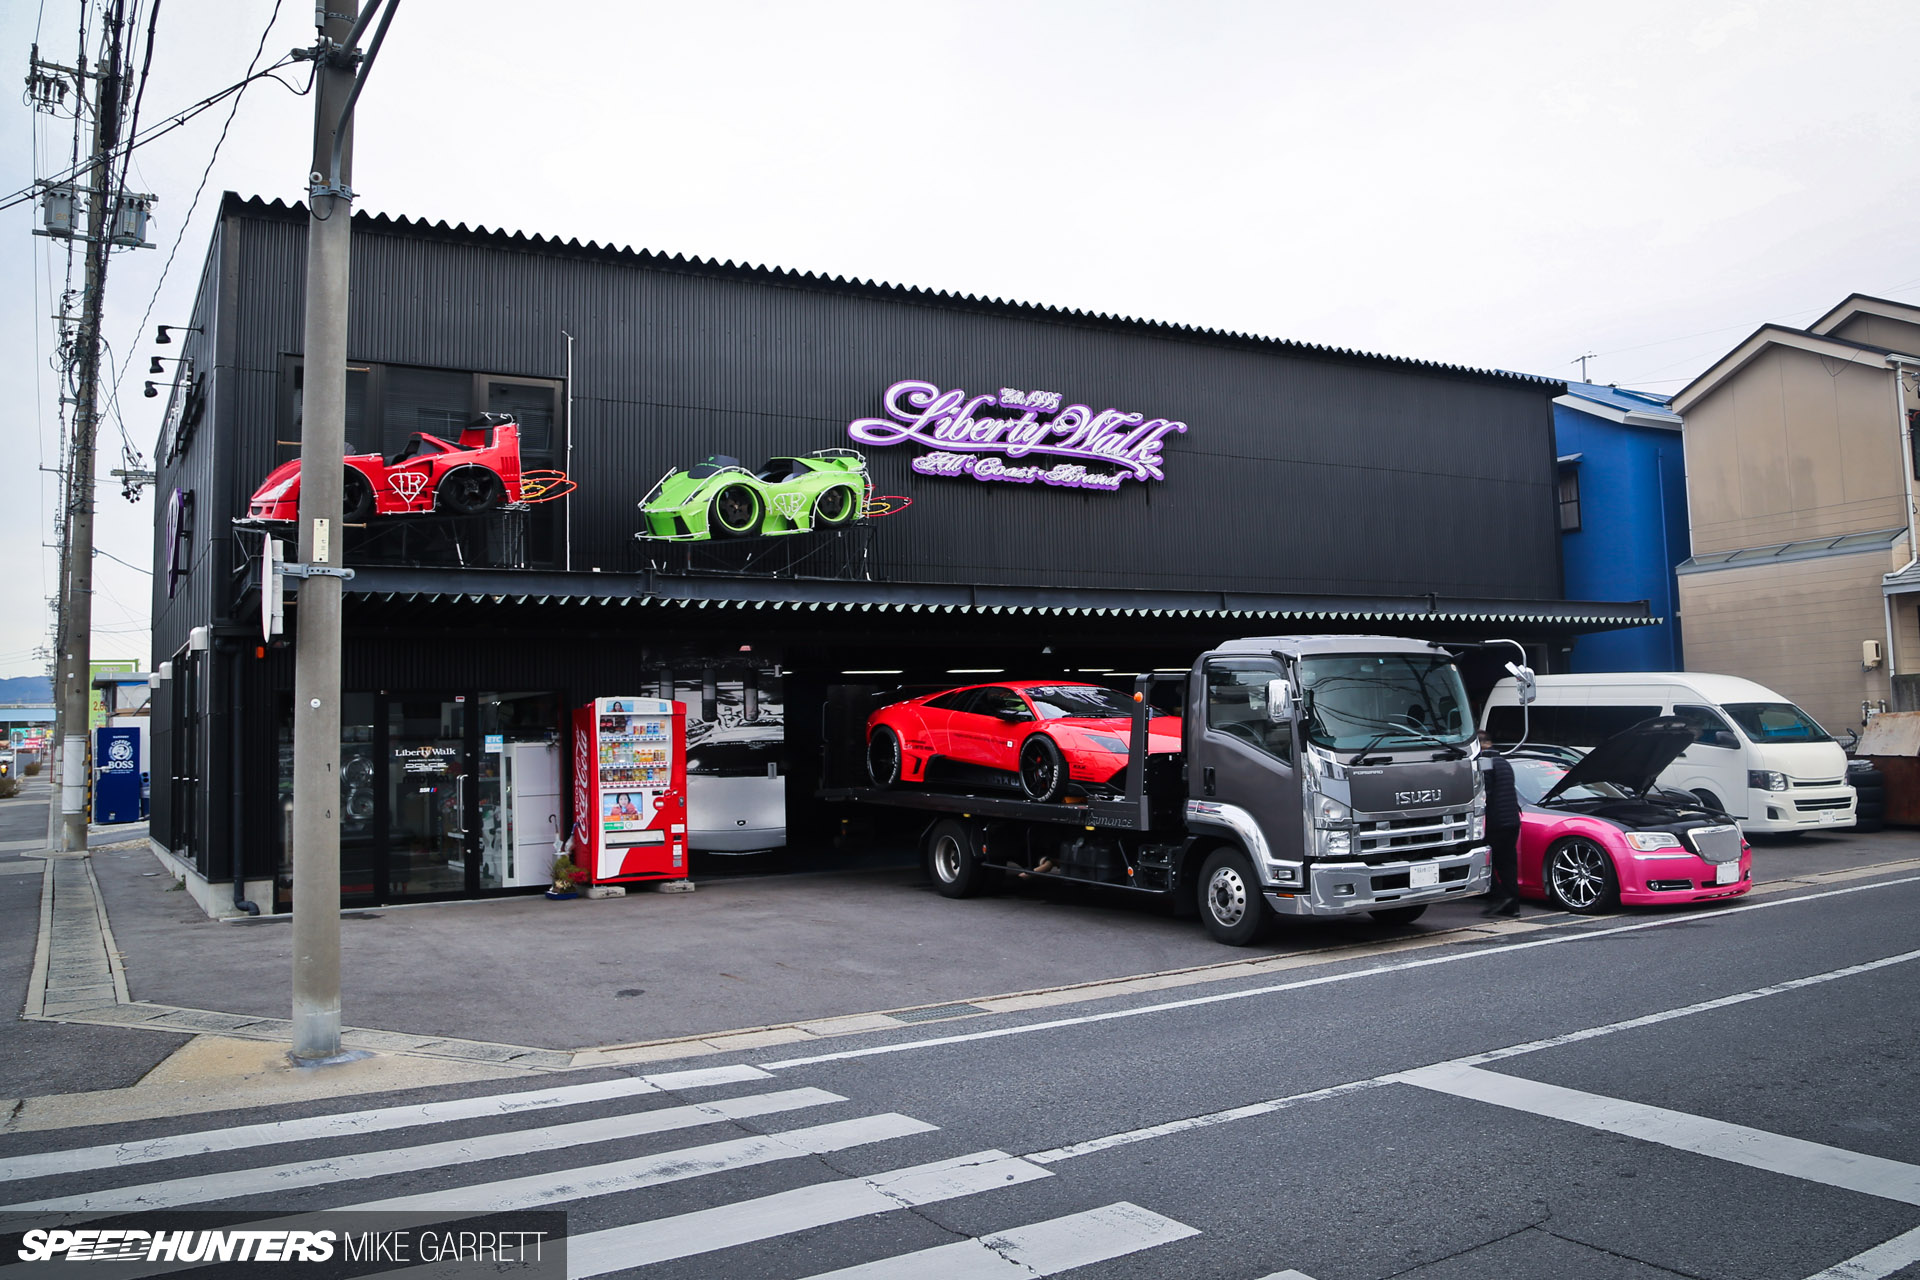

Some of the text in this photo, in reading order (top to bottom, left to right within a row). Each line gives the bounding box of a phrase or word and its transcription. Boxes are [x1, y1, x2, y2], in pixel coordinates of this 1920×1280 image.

[849, 380, 1187, 468] Liberty Walk
[1044, 463, 1132, 488] Brand
[395, 747, 456, 758] Liberty Walk
[108, 760, 134, 769] BOSS
[574, 726, 589, 845] Coca-Cola
[1395, 789, 1442, 806] ISUZU
